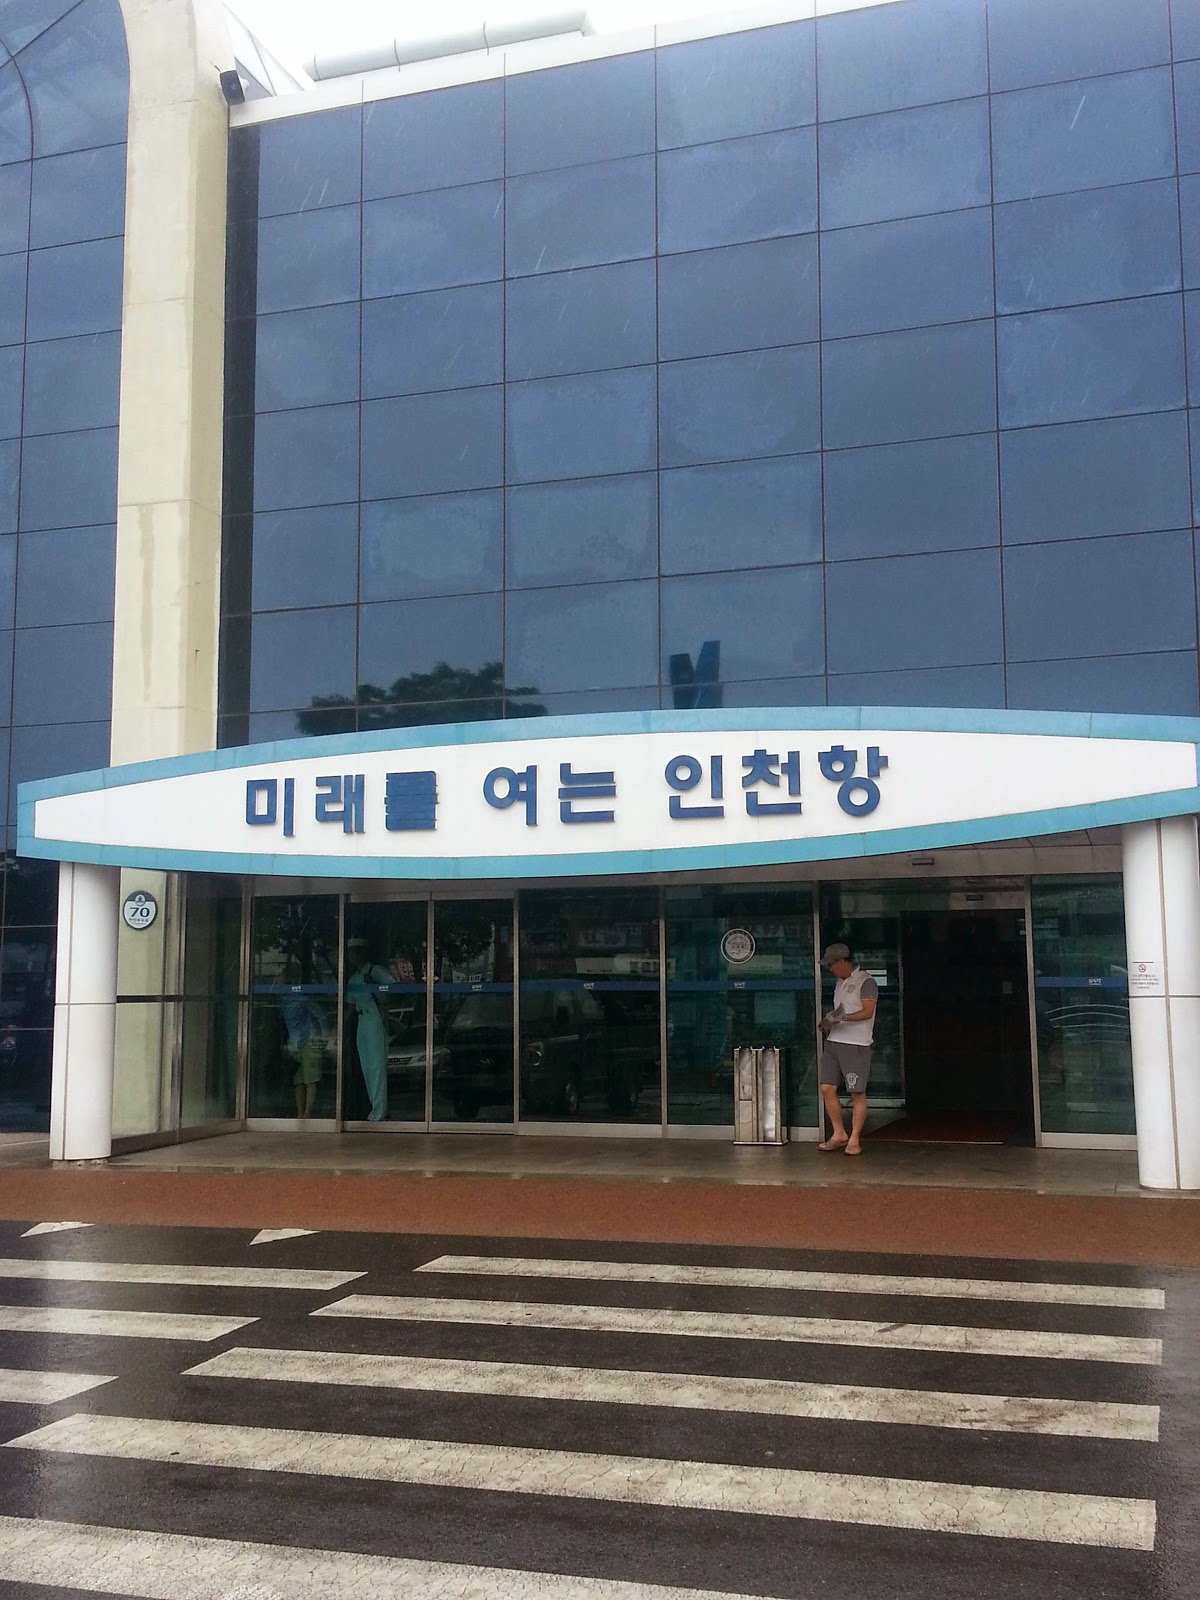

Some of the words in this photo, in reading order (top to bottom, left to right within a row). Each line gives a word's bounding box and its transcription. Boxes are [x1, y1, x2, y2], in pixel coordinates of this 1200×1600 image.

[245, 770, 439, 837] 미래를
[483, 762, 617, 826] 여는
[664, 745, 888, 818] 인천항
[130, 906, 150, 918] 70
